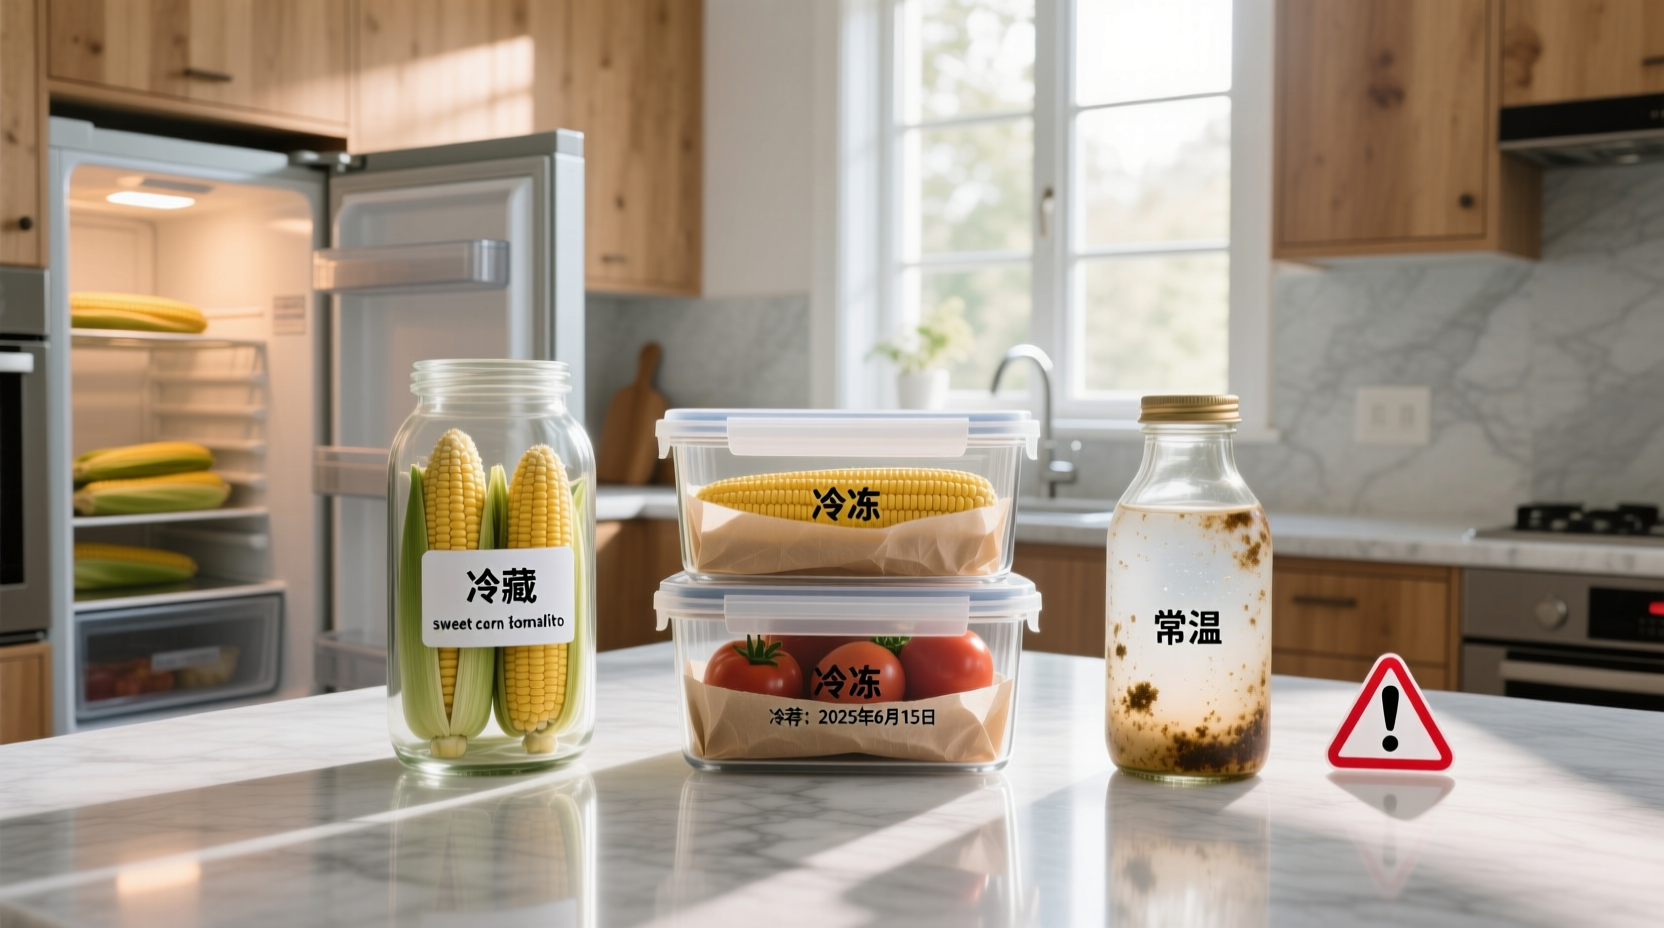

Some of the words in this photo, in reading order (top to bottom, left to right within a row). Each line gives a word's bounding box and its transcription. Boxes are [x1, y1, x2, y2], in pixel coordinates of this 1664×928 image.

[812, 486, 881, 522] 冷冻
[466, 567, 537, 604] 冷藏
[433, 618, 472, 630] sweet
[1154, 609, 1222, 646] 常温
[813, 664, 881, 699] 冷冻
